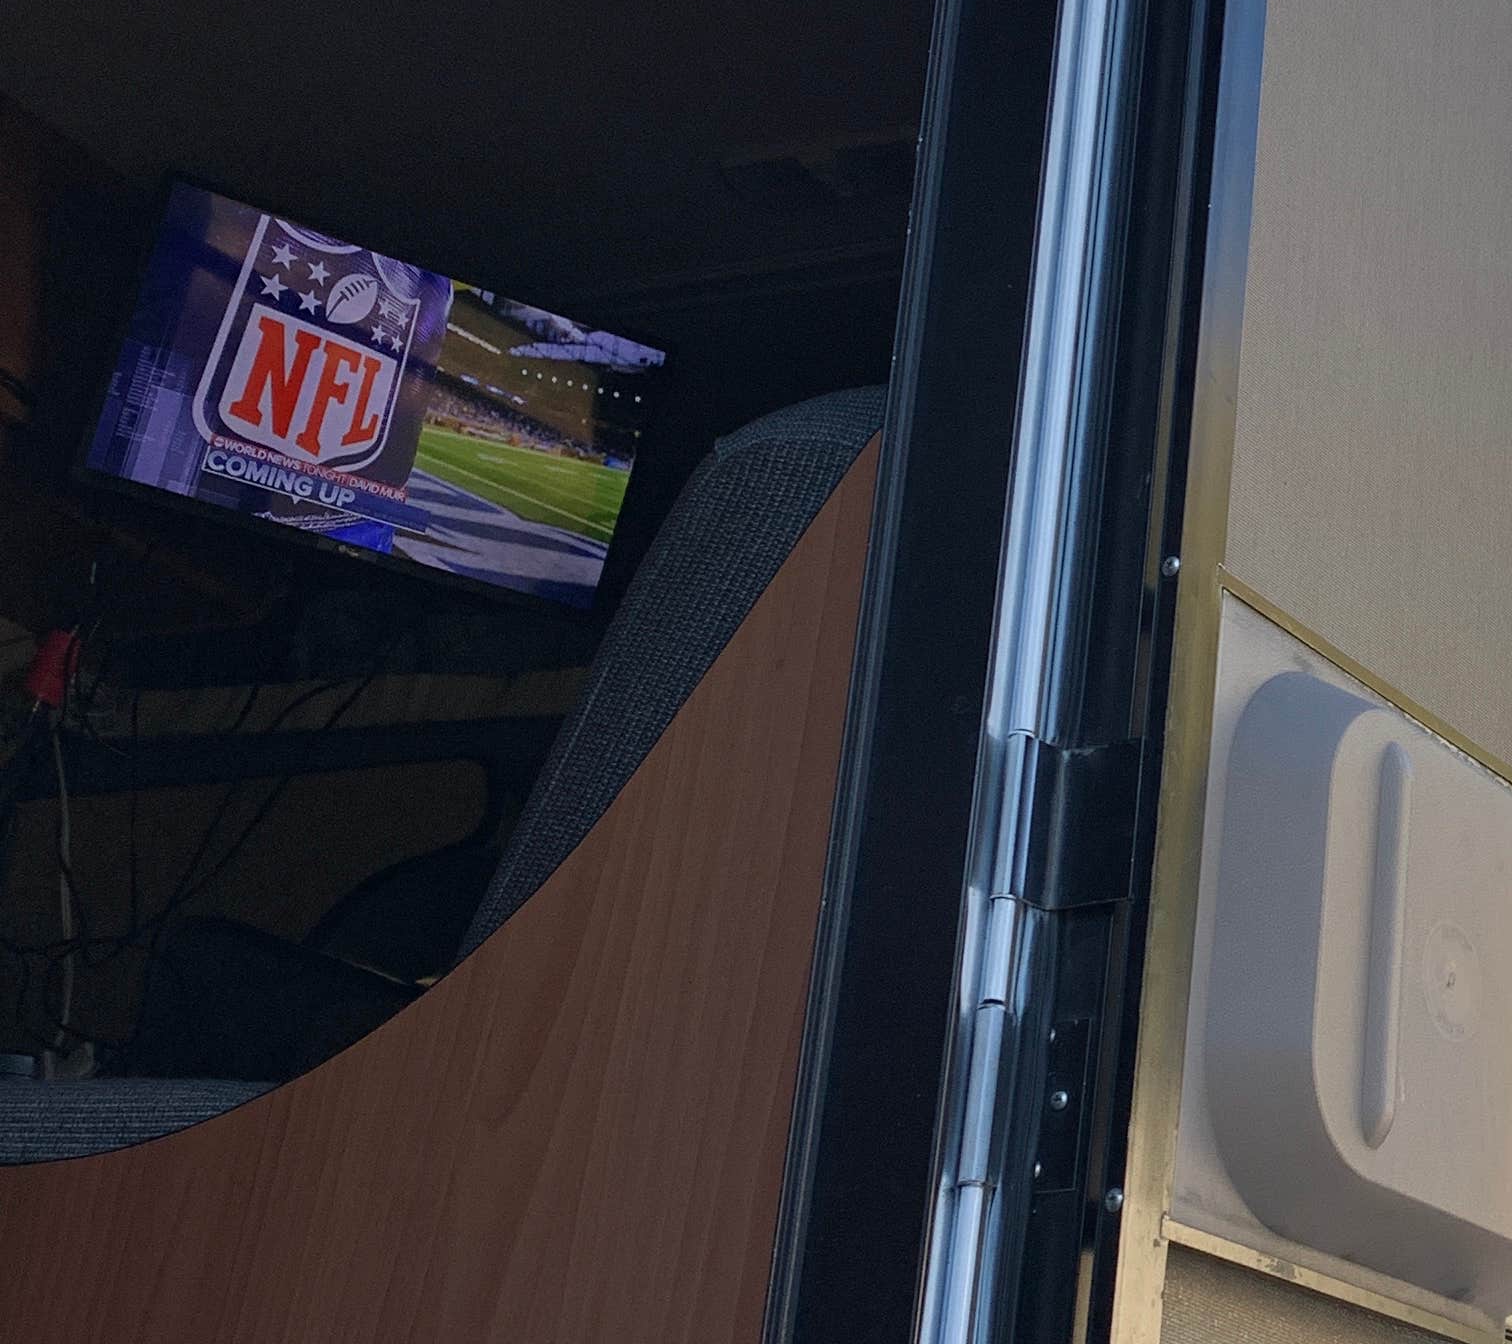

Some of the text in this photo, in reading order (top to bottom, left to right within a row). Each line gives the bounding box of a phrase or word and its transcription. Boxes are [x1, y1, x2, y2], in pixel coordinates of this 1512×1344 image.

[229, 315, 381, 457] NFL
[207, 450, 355, 507] COMING UP
[225, 439, 267, 460] WORLD
[267, 452, 301, 471] NEWS
[303, 462, 347, 485] TONIGHT
[349, 478, 379, 494] DAVID
